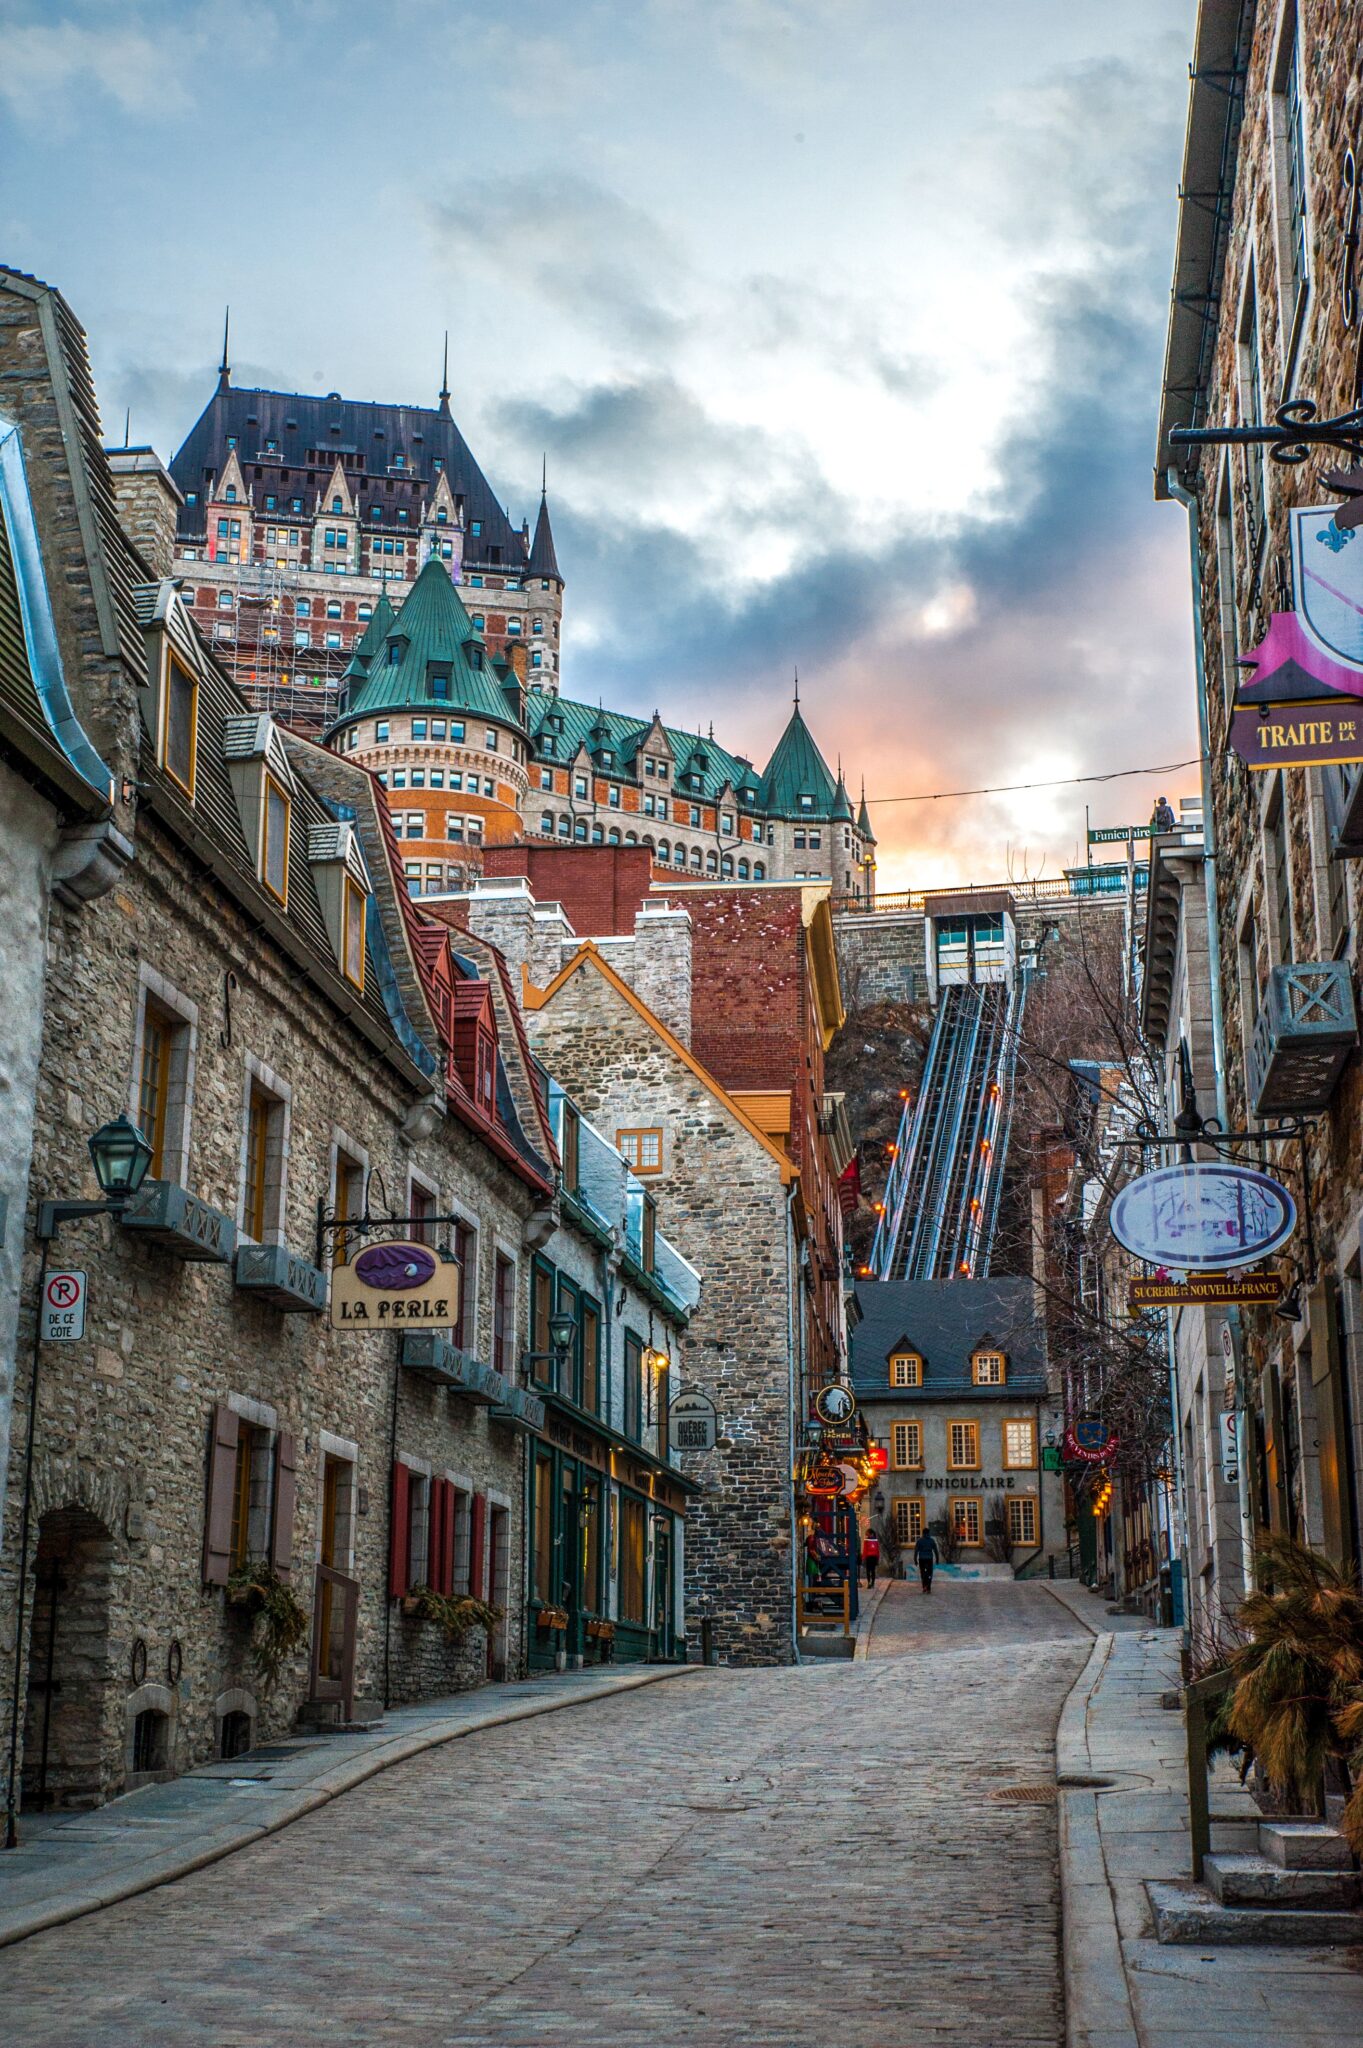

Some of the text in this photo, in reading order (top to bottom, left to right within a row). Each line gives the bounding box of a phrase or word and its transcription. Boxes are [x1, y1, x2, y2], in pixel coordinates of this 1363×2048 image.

[1257, 721, 1356, 748] TRAITE DE
[1339, 731, 1356, 741] LA
[1095, 828, 1151, 841] Funicuaire
[1134, 1286, 1180, 1298] SUCRERIE
[1190, 1282, 1278, 1296] NOUVELLE-FRANCE
[341, 1300, 449, 1319] LA PERLE
[49, 1313, 75, 1324] DE CE
[678, 1434, 707, 1446] URBAIN
[915, 1477, 1015, 1489] FUNICULAIRE
